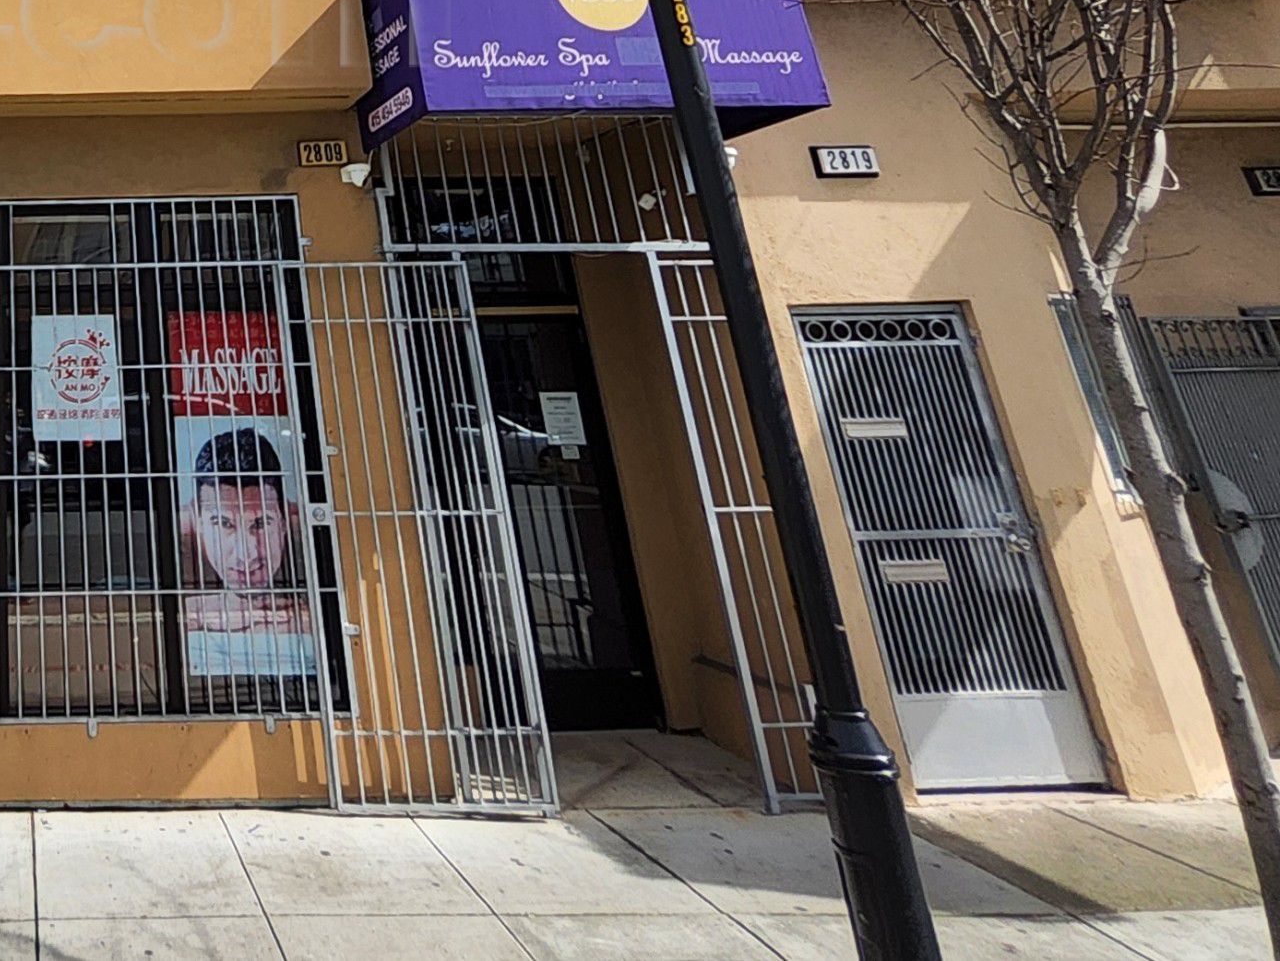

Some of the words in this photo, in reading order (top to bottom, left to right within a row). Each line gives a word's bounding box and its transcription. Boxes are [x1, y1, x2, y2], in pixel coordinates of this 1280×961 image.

[433, 39, 549, 78] Sunflower
[558, 38, 611, 77] Spa
[696, 36, 803, 74] Massage
[303, 142, 343, 163] 2809
[827, 150, 873, 170] 2819
[55, 355, 102, 379] 按摩
[178, 347, 282, 395] MASSAGE
[64, 383, 78, 391] AN
[80, 383, 96, 391] MO
